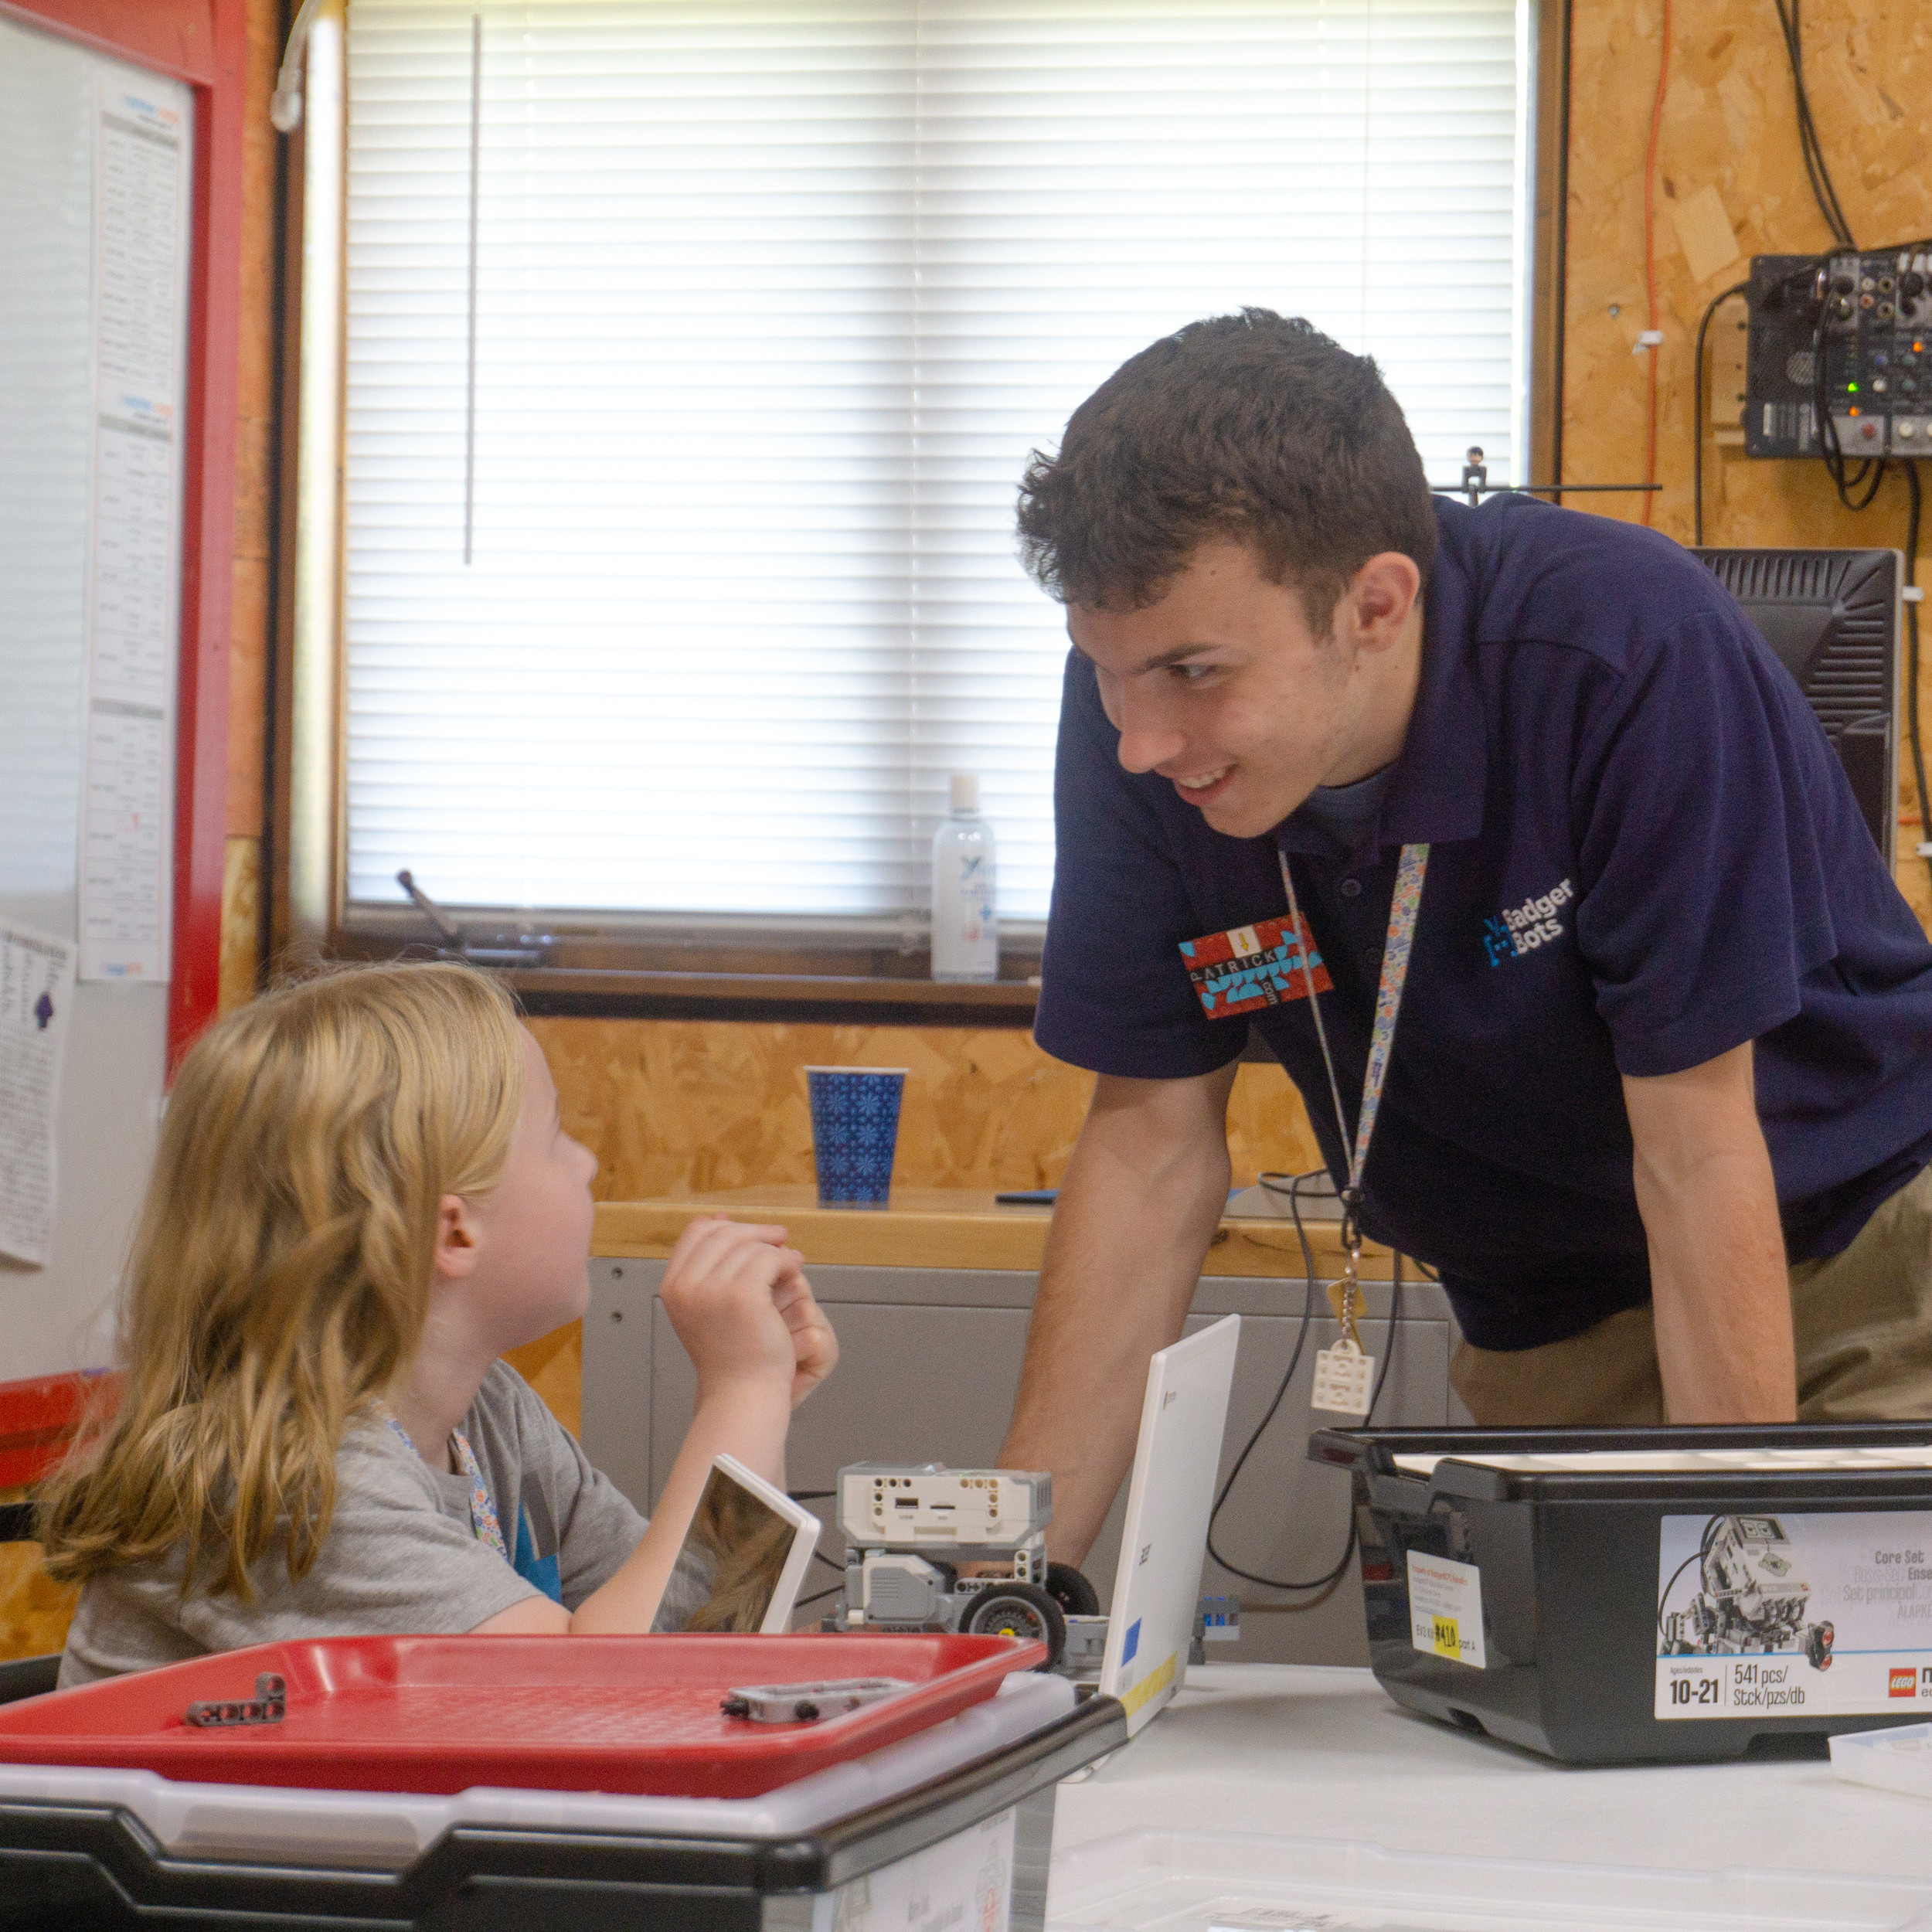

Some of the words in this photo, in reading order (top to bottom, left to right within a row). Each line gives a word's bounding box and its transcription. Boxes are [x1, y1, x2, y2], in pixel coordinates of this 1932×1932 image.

[1190, 950, 1277, 982] PATRICK
[1874, 1550, 1902, 1565] Core
[1904, 1549, 1925, 1564] Set
[1843, 1584, 1864, 1601] Set
[1866, 1583, 1915, 1605] principal
[1735, 1663, 1758, 1684] 541
[1761, 1665, 1788, 1688] pcs/
[1890, 1676, 1915, 1689] LEGO
[1670, 1679, 1719, 1704] 10-21
[1733, 1686, 1805, 1709] Stck/pzs/db
